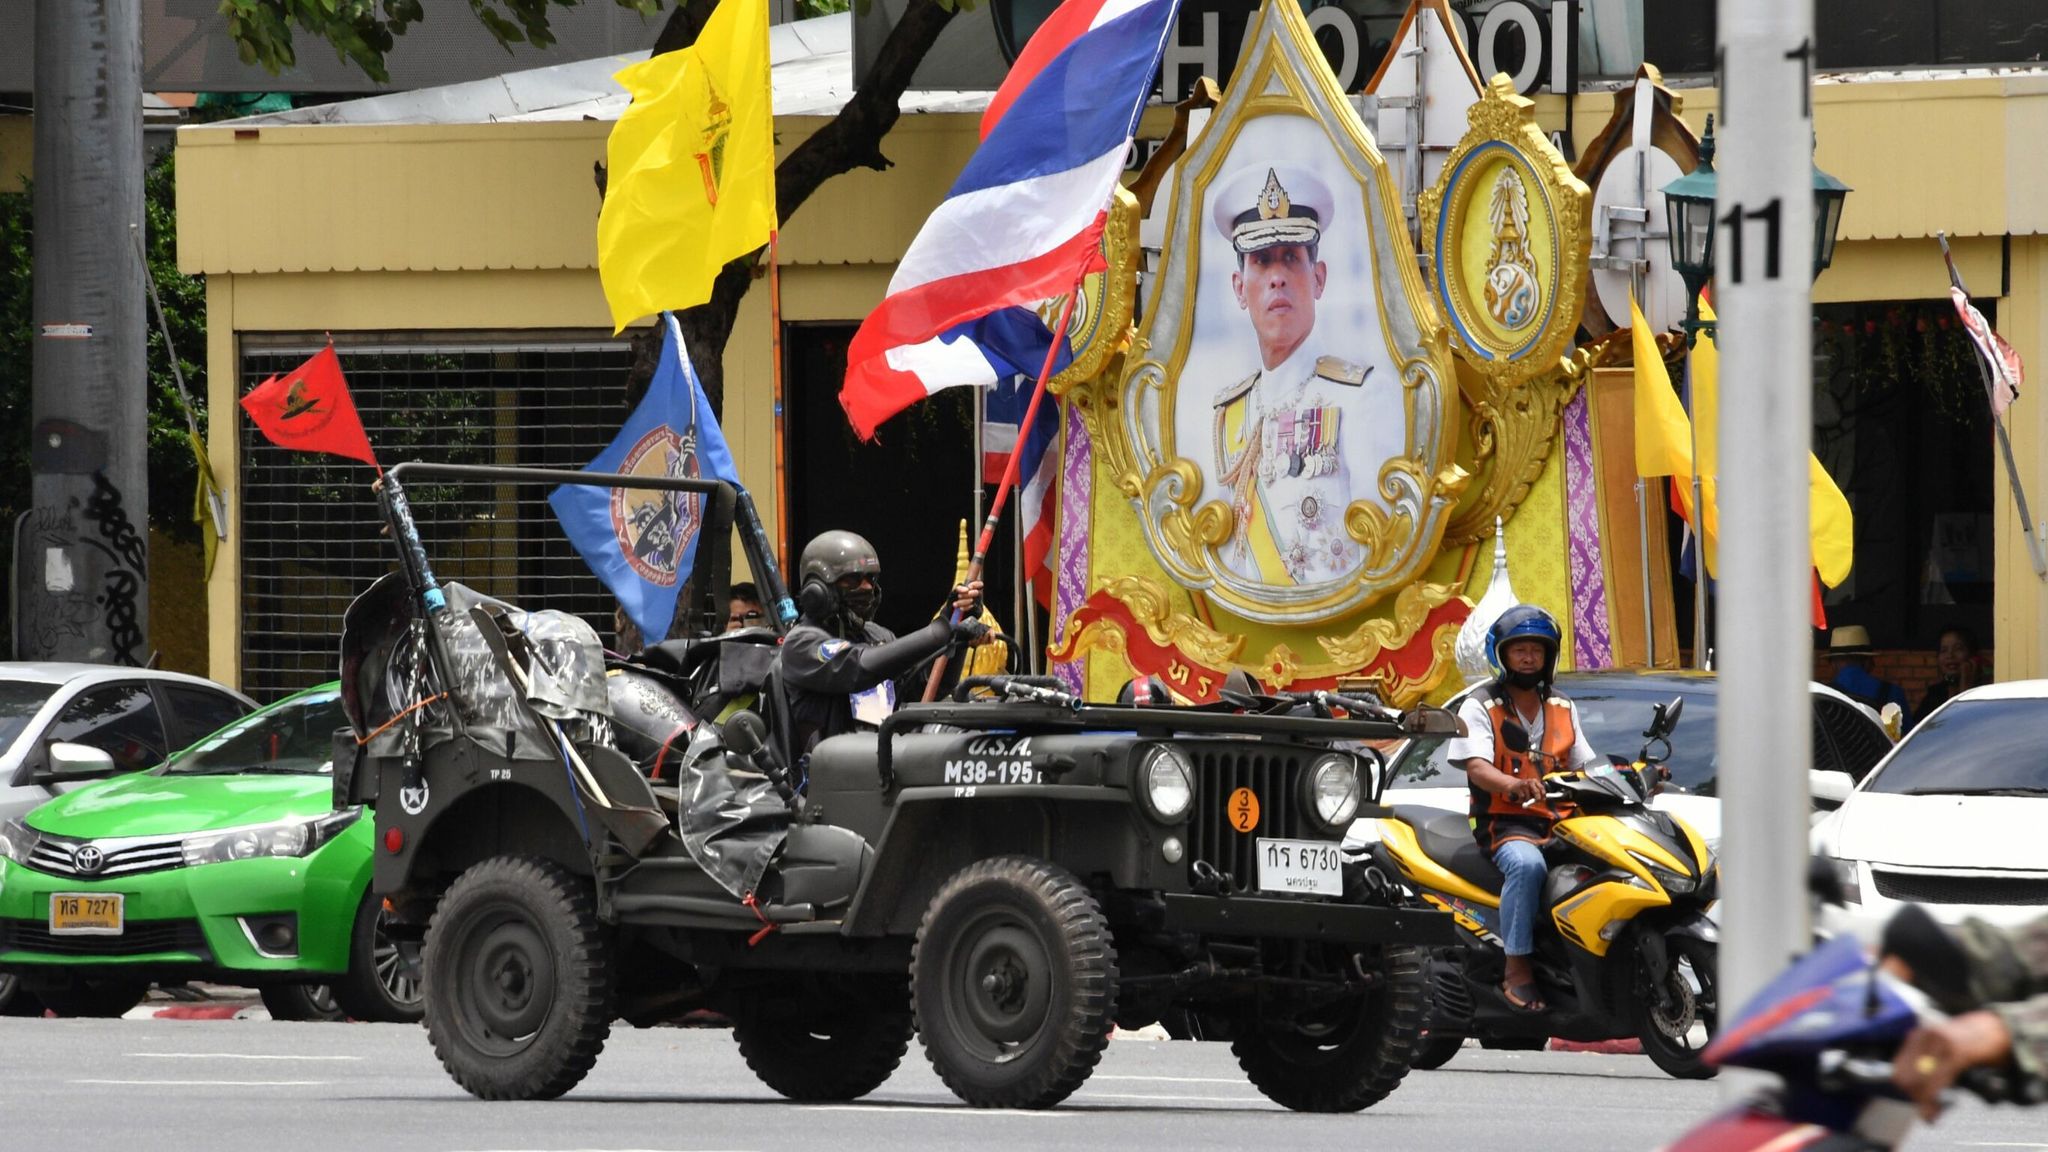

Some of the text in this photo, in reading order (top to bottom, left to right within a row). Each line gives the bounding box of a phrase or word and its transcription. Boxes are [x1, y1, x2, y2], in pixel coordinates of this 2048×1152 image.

[1449, 0, 1568, 95] OI
[1718, 198, 1781, 284] 11
[968, 737, 1032, 756] U.S.A.
[1268, 843, 1338, 871] กร 6730
[86, 899, 116, 915] 7271
